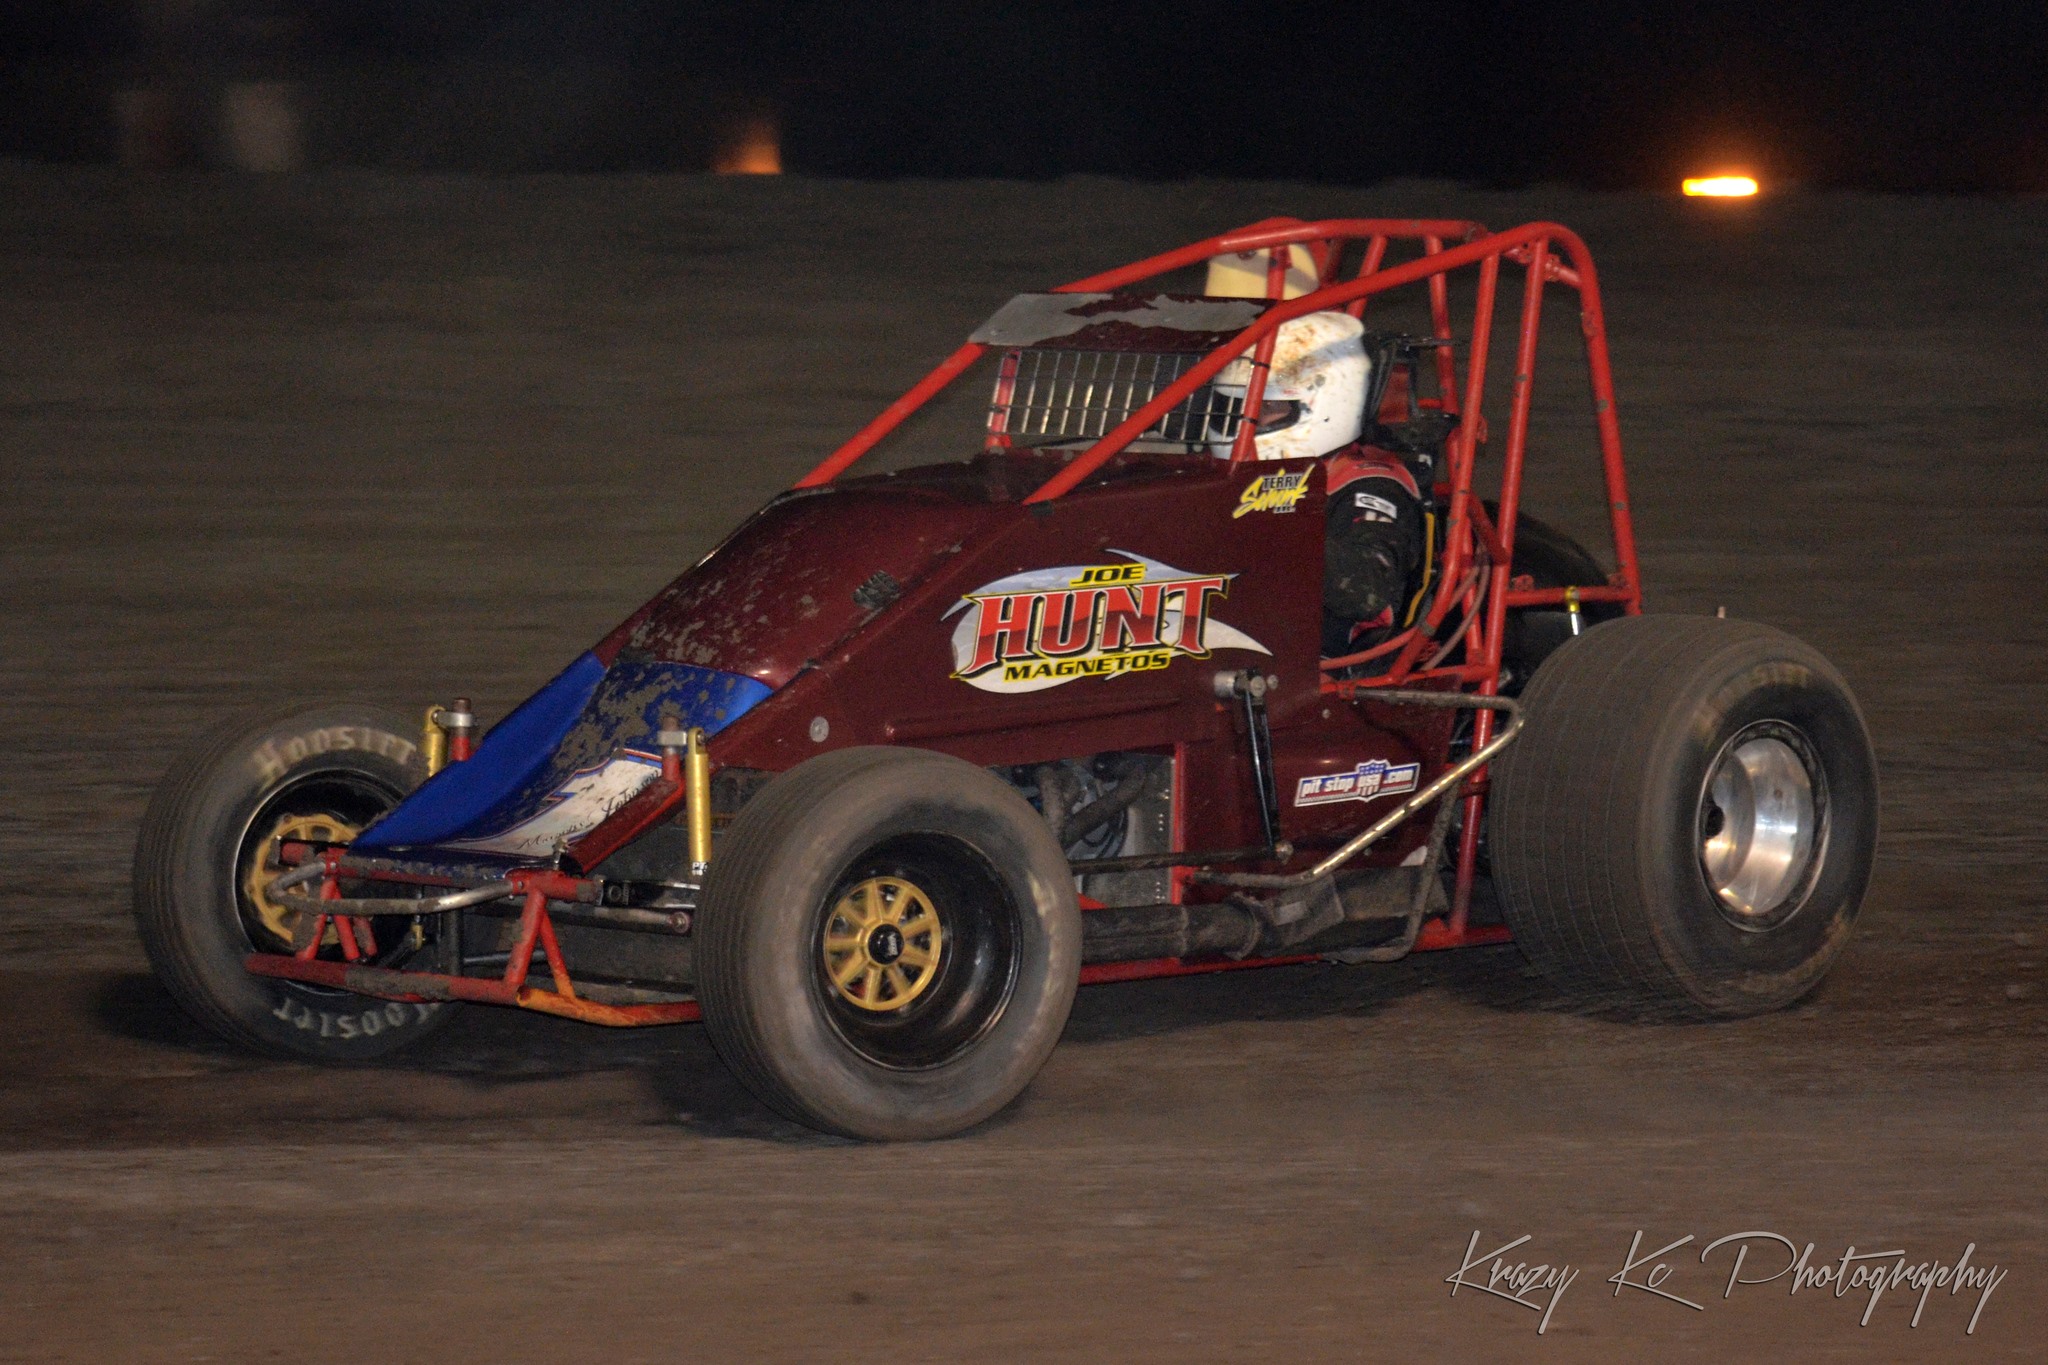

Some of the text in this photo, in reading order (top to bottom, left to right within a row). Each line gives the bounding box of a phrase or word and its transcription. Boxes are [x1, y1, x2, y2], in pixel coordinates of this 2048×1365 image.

[1262, 475, 1303, 490] TERRY
[1070, 564, 1146, 586] JOE
[957, 576, 1227, 678] HUNT
[1004, 654, 1170, 681] MAGNETOS
[1300, 779, 1322, 798] pit
[1324, 776, 1356, 793] stop
